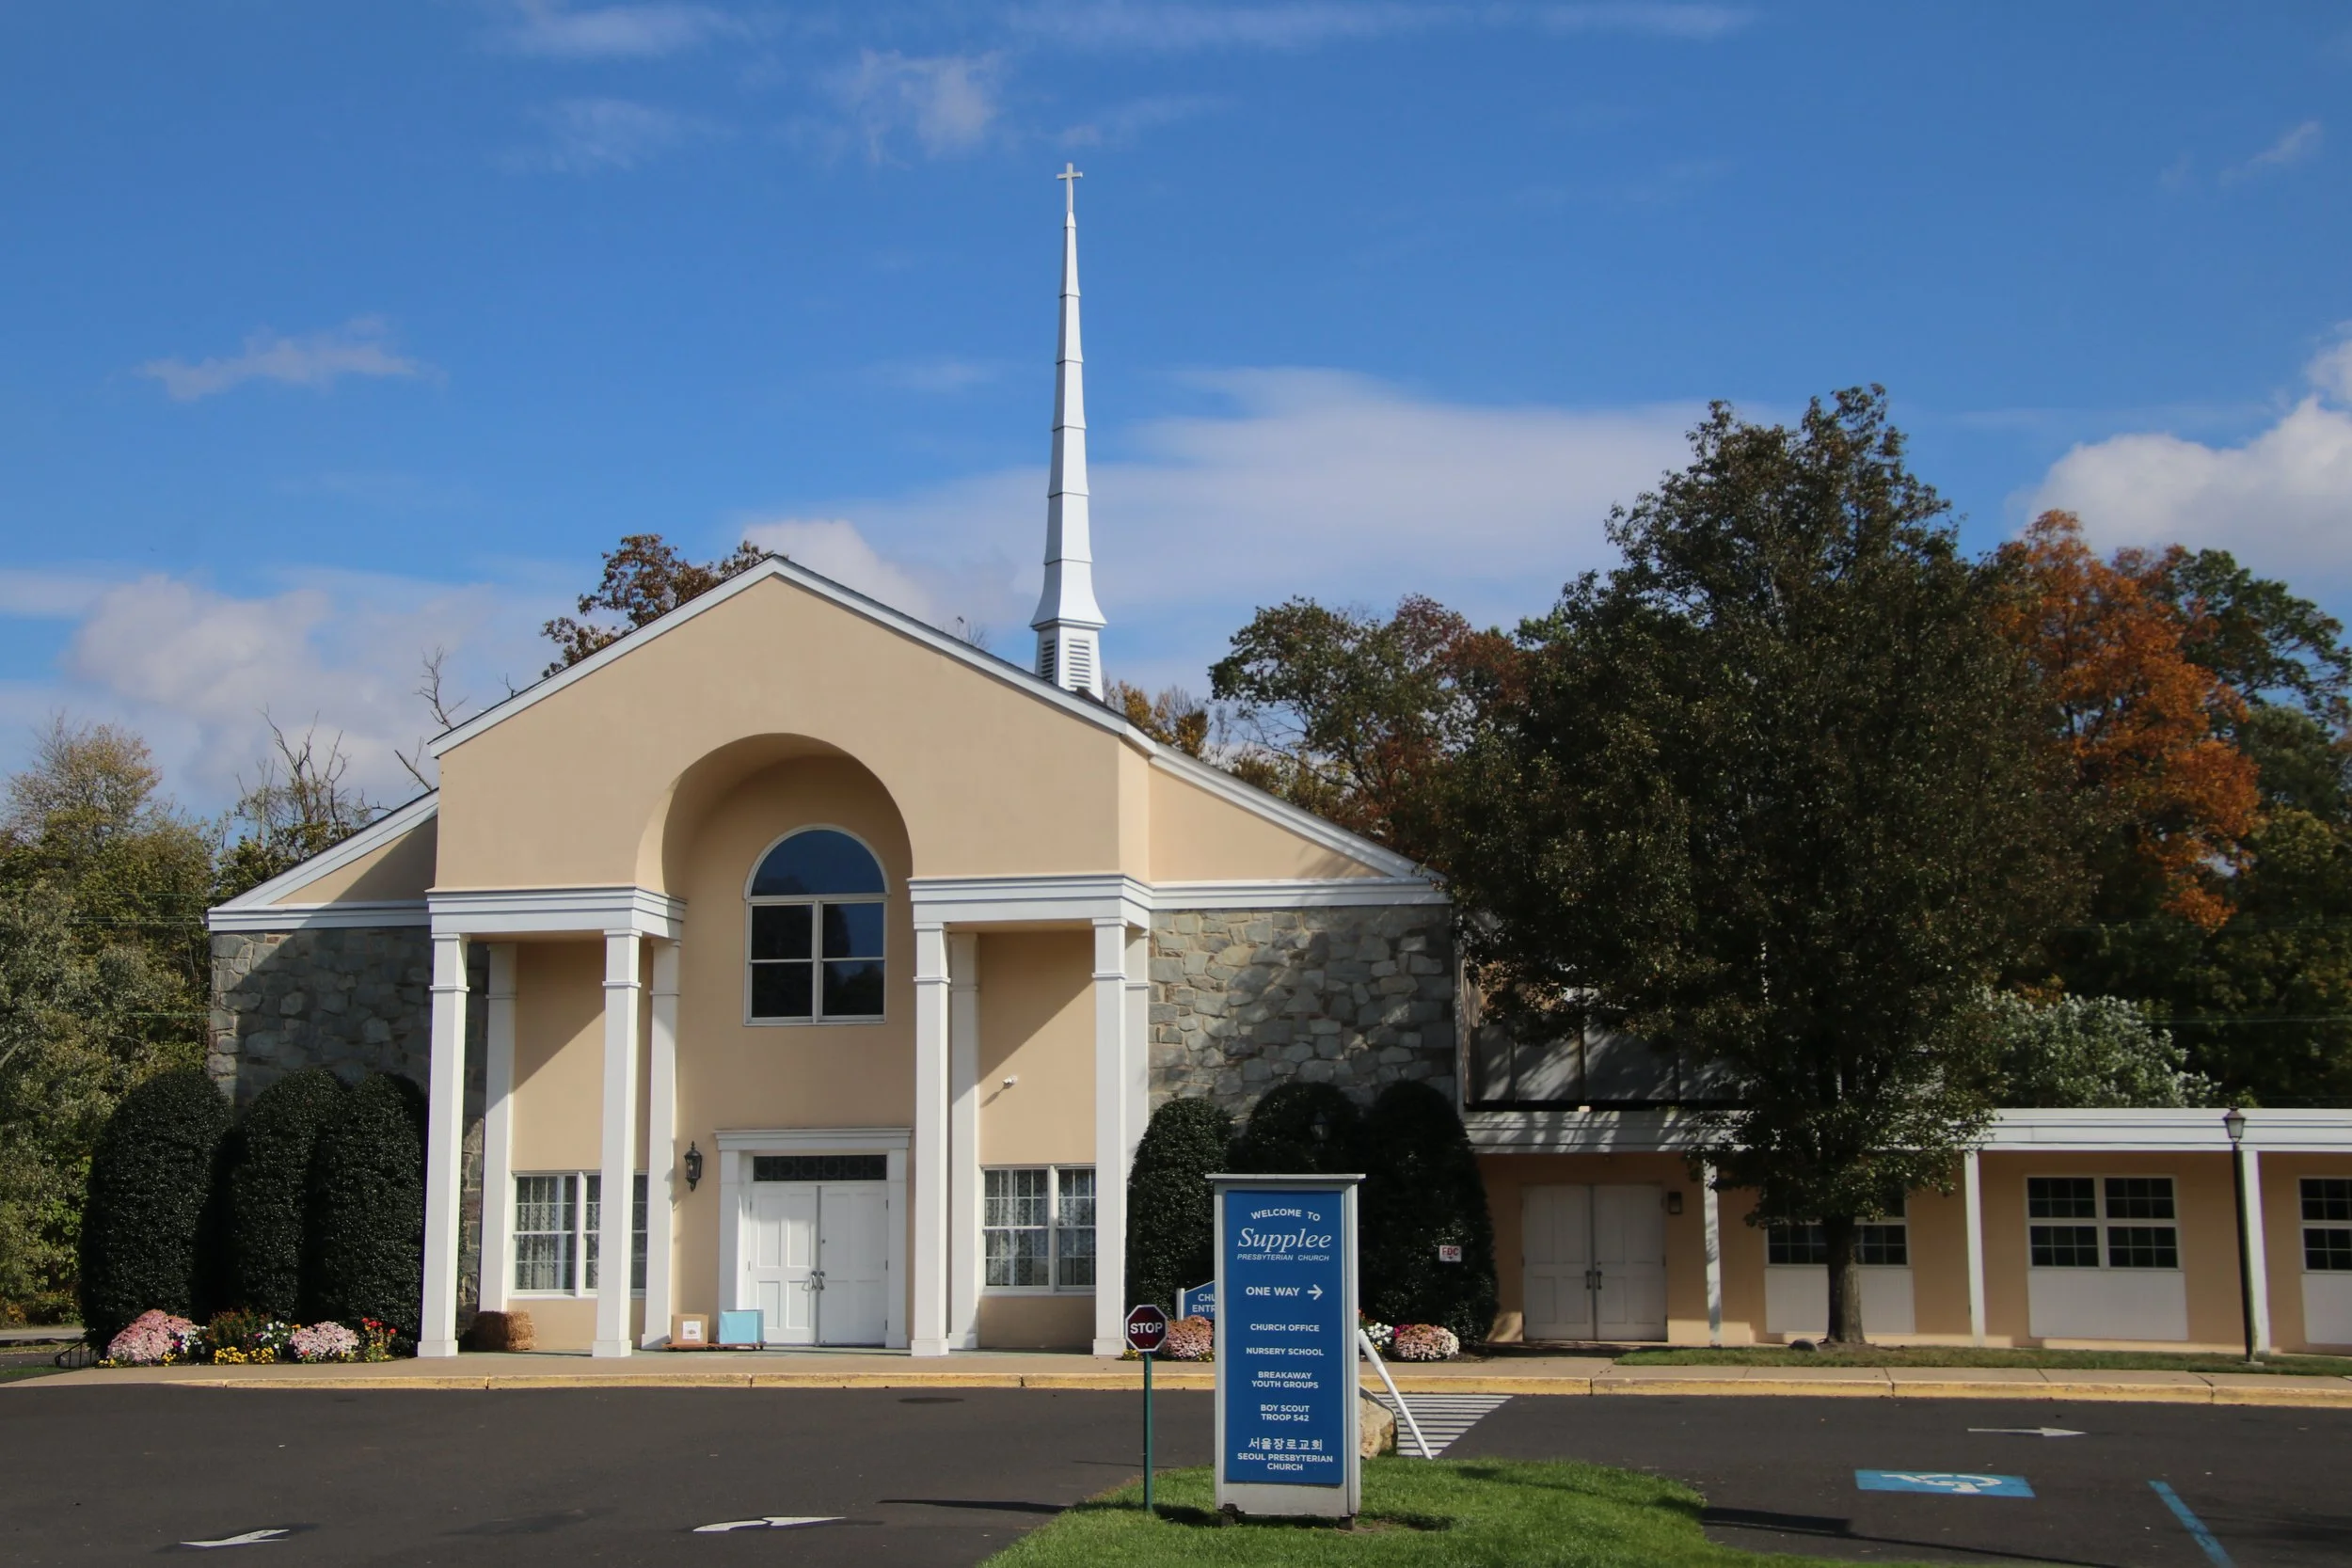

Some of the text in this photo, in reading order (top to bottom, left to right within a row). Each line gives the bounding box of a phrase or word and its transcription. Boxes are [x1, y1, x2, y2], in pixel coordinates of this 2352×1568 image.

[1250, 1208, 1321, 1222] WELCOME TO
[1237, 1227, 1332, 1253] Supplee
[1236, 1253, 1294, 1261] PRESBYTERIAN
[1441, 1247, 1459, 1257] FDC
[1246, 1286, 1301, 1297] ONE WAY
[1130, 1322, 1163, 1334] STOP
[1249, 1323, 1320, 1332] CHURCH OFFICE
[1246, 1347, 1325, 1356] NURSERY SCHOOL
[1258, 1370, 1312, 1380] BREAKAWAY
[1251, 1380, 1319, 1389] YOUTH GROUPS
[1260, 1403, 1311, 1413] BOY SCOUT
[1261, 1413, 1310, 1422] TROOP 542
[1248, 1436, 1323, 1451] 서울장로교회
[1237, 1452, 1333, 1463] SEOUL PRESBYTERIAN
[1266, 1463, 1304, 1471] CHURCH
